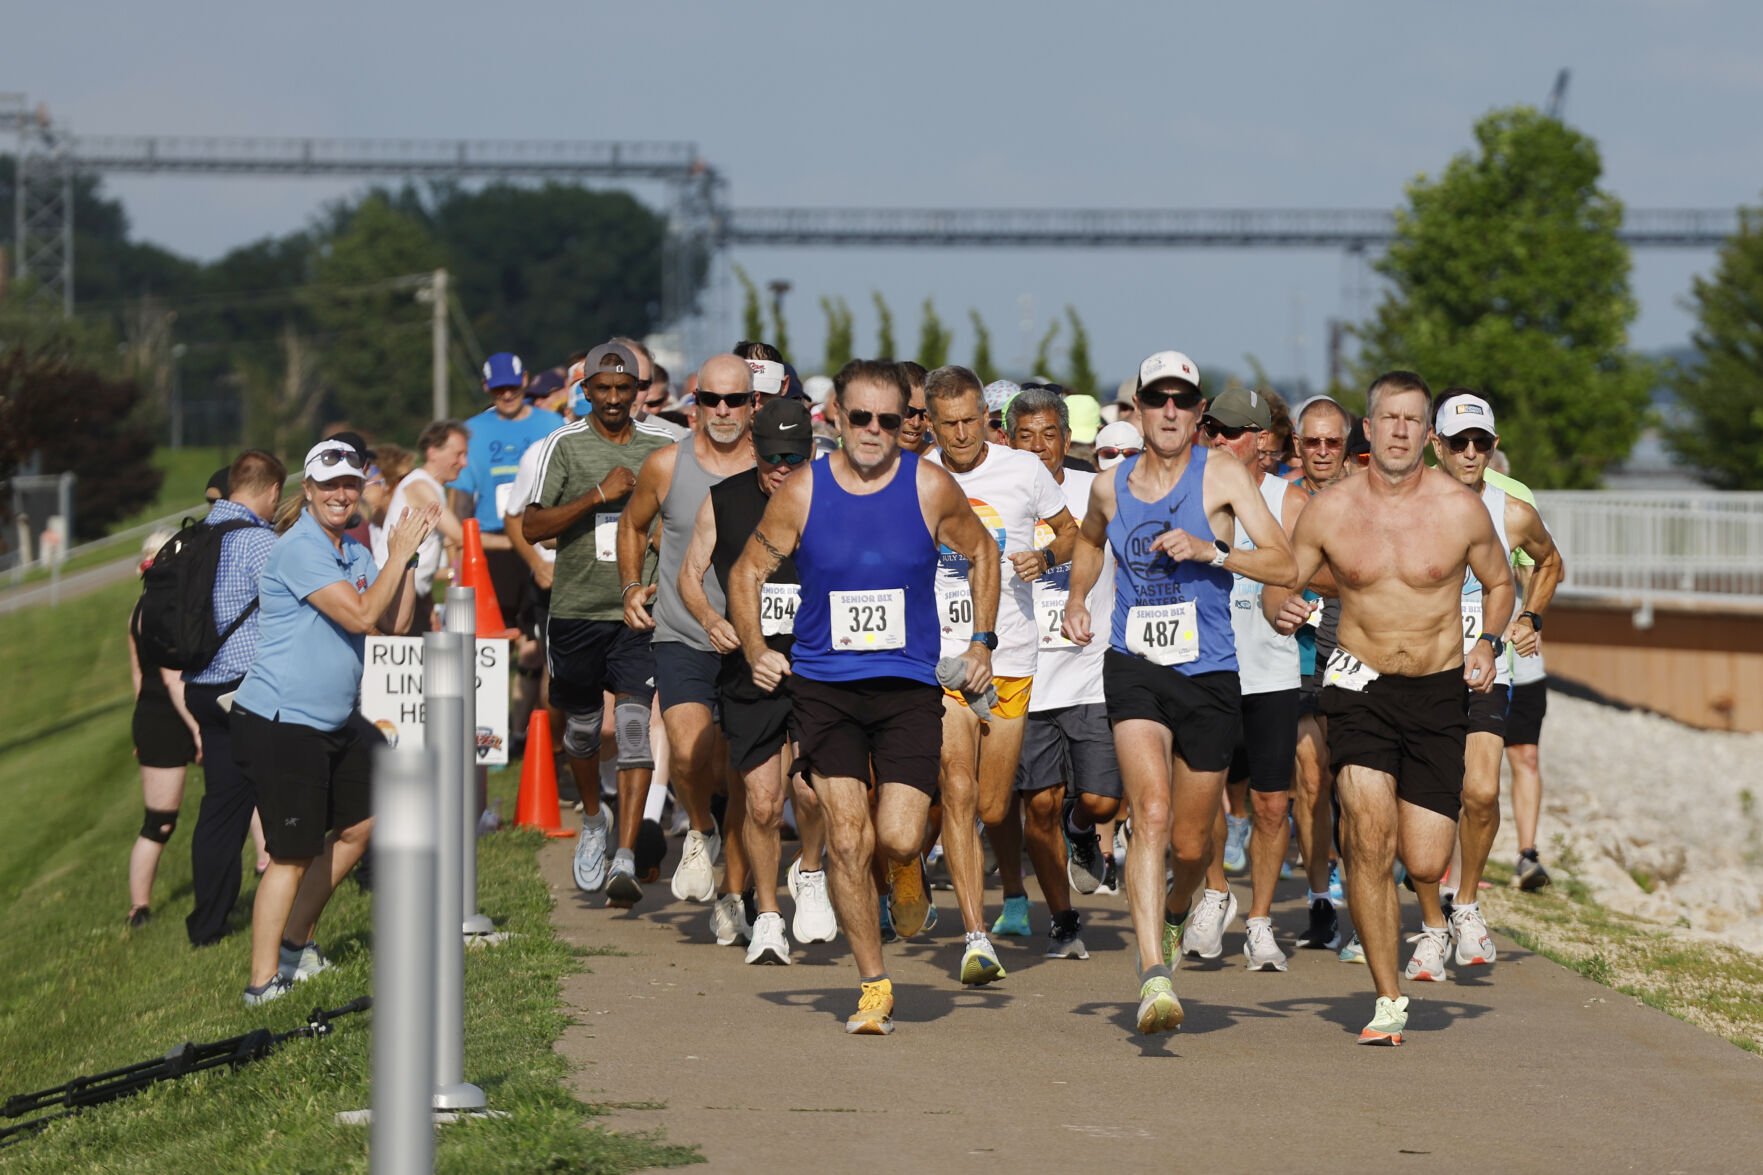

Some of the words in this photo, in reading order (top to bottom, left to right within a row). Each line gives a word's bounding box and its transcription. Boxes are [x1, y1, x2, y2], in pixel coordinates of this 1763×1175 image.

[762, 586, 785, 594] ENIOR
[841, 594, 875, 604] SENIOR
[877, 594, 893, 602] BIX
[1133, 582, 1181, 596] FASTER
[761, 597, 795, 620] 264
[949, 599, 972, 624] 50
[1041, 600, 1065, 608] SENIO
[1137, 609, 1169, 618] SENIOR
[1170, 608, 1185, 616] BIX
[849, 605, 887, 632] 323
[1143, 619, 1180, 647] 487
[372, 644, 496, 668] RUNS
[386, 673, 424, 694] LIN
[400, 703, 427, 724] HE
